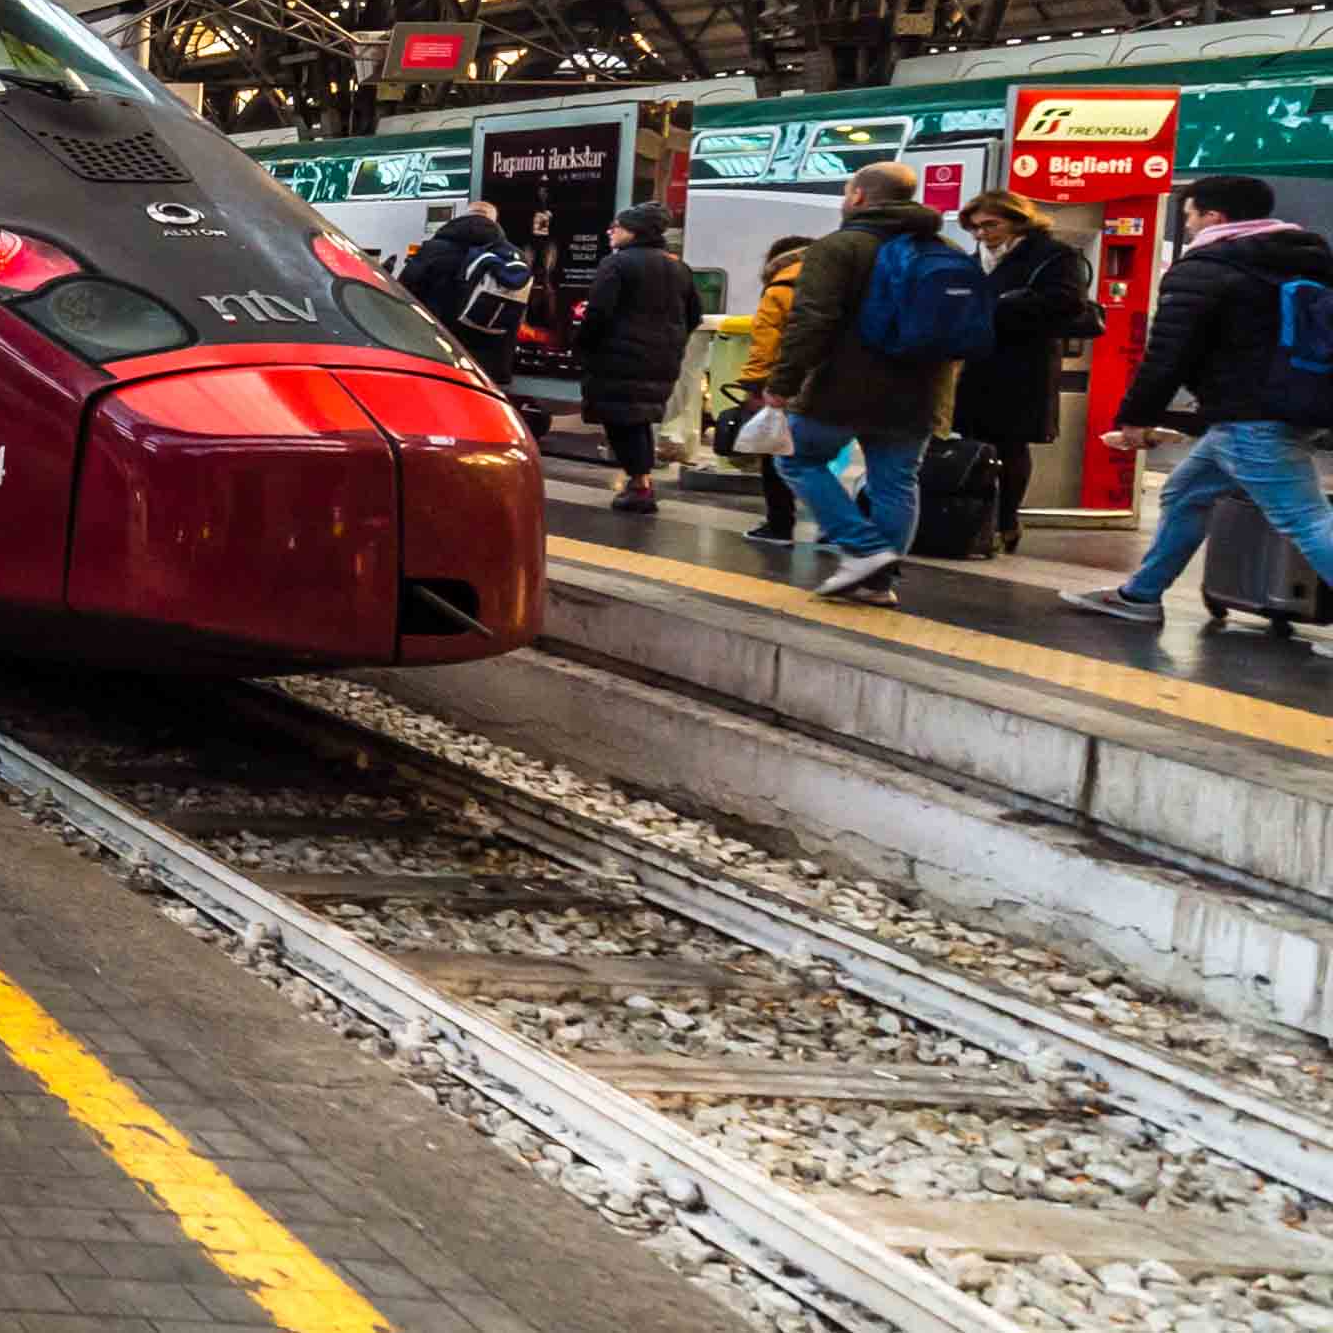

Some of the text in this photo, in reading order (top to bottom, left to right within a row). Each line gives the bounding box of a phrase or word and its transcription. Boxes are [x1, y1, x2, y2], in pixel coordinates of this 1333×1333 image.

[1066, 126, 1149, 137] TRENITALIA
[492, 144, 607, 179] Paganini Rockstar
[1048, 155, 1133, 177] Biglietti
[1049, 176, 1085, 187] Tickets
[163, 227, 228, 238] ALSTOM
[198, 289, 318, 323] ntv
